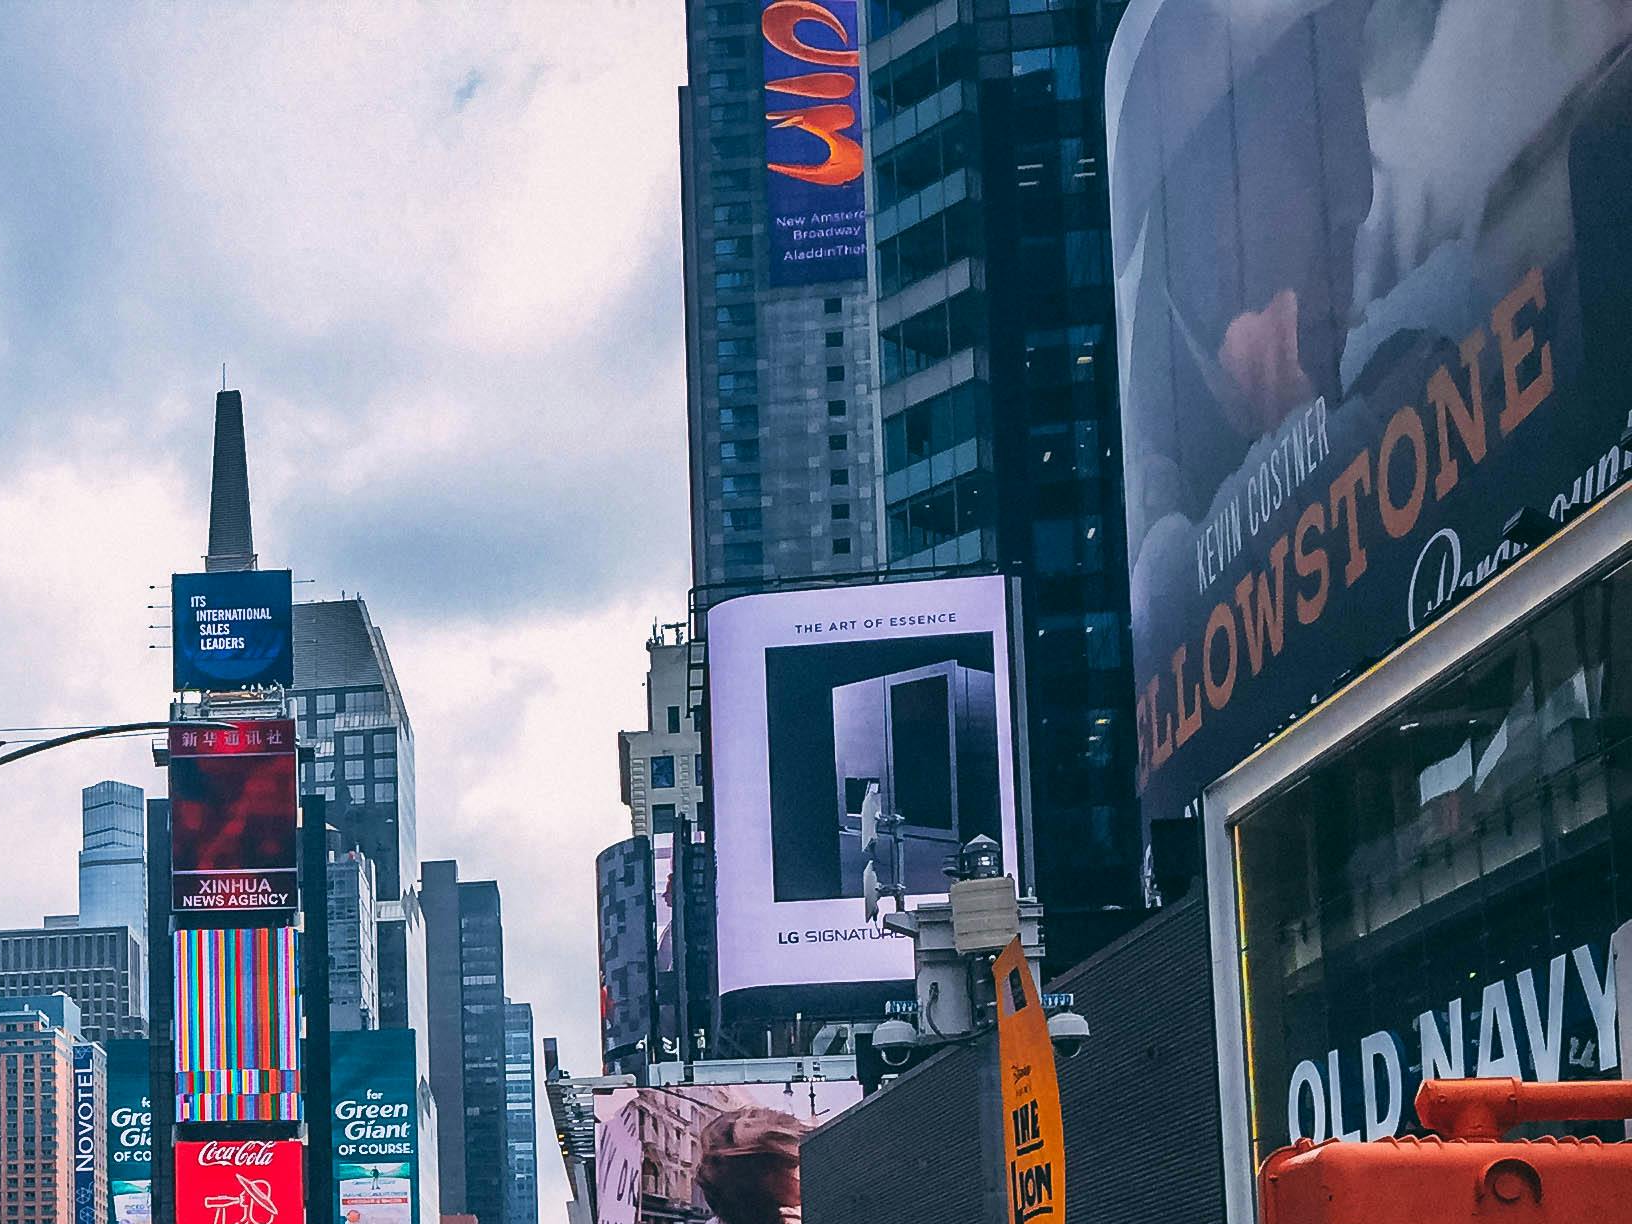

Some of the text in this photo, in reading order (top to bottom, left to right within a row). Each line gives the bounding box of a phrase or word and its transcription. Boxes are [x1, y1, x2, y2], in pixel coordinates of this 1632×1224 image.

[776, 215, 805, 228] New
[793, 225, 861, 241] Broadway
[1196, 396, 1331, 595] KEVIN COSTNER
[191, 596, 206, 608] ITS
[196, 607, 272, 622] INTERNATIONAL
[200, 623, 230, 636] SALES
[795, 612, 957, 634] THE ART OF ESSENCE
[200, 637, 245, 650] LEADERS
[182, 729, 283, 747] 新华通讯社
[198, 878, 272, 894] XINHUA
[183, 893, 288, 908] NEWS AGENCY
[778, 931, 800, 944] LG
[1288, 944, 1617, 1143] OLD NAVY
[367, 1089, 383, 1099] for
[75, 1058, 94, 1172] NOVOTEL
[111, 1107, 151, 1127] Gre
[335, 1100, 408, 1120] Green
[344, 1119, 411, 1140] Giant
[1012, 1099, 1041, 1148] THE
[114, 1151, 151, 1162] OF CO
[339, 1143, 414, 1155] OF COURSE.
